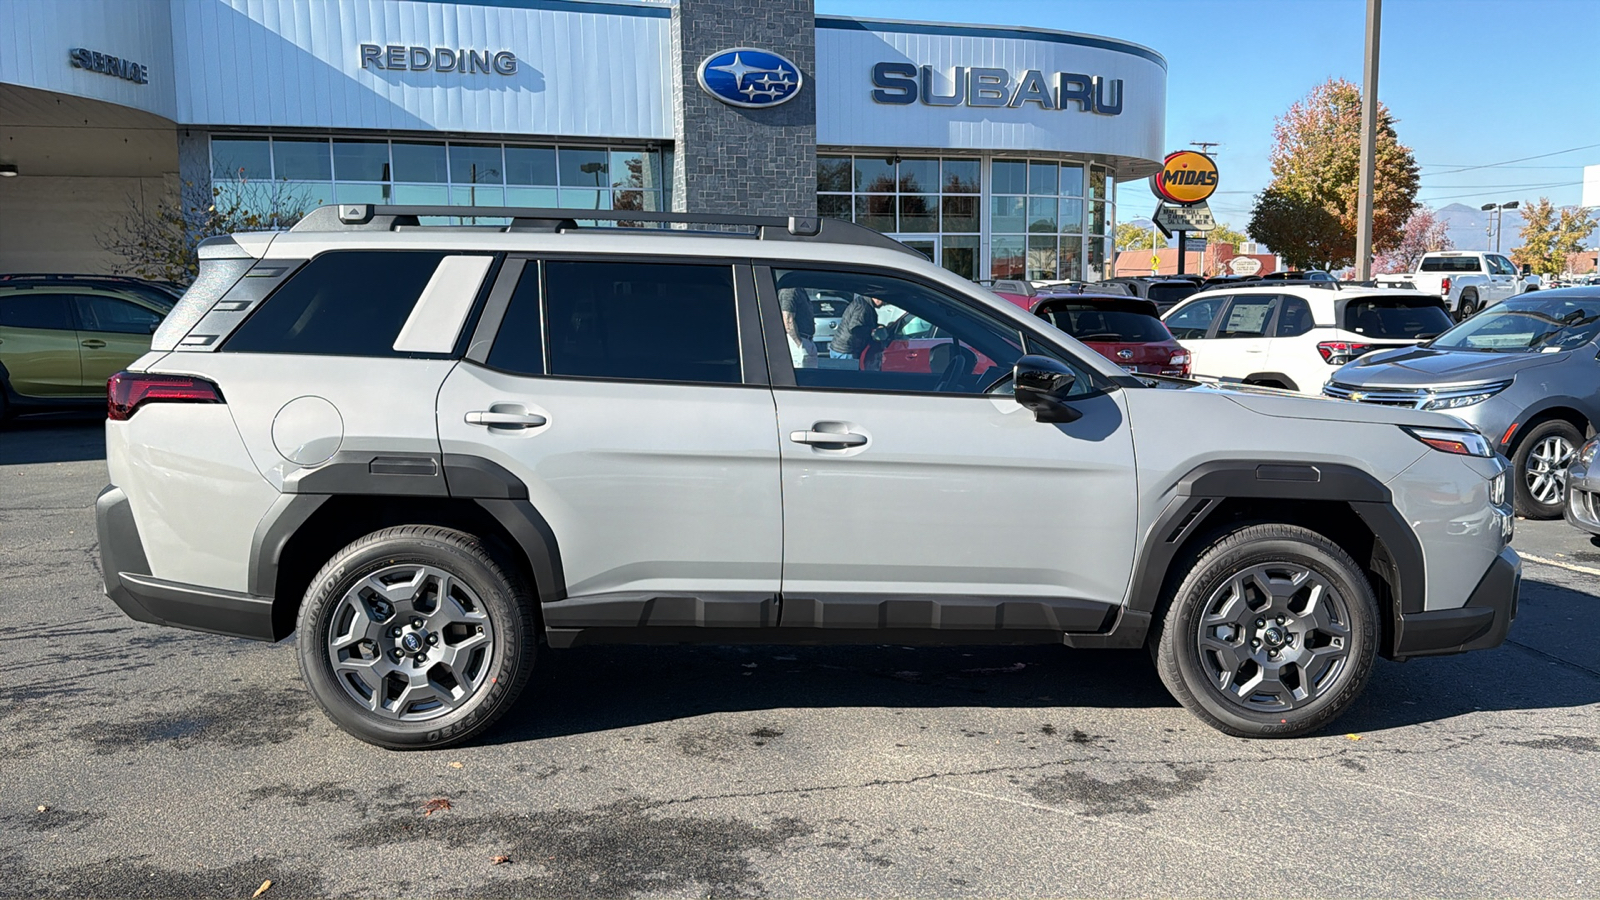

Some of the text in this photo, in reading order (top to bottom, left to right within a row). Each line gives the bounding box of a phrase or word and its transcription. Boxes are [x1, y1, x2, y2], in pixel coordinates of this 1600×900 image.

[70, 48, 148, 84] SERVICE
[360, 44, 518, 75] REDDING
[872, 62, 1123, 115] SUBARU
[1163, 169, 1217, 187] MIDAS
[1187, 549, 1243, 608] DUNLOP
[306, 566, 345, 636] DUNLOP
